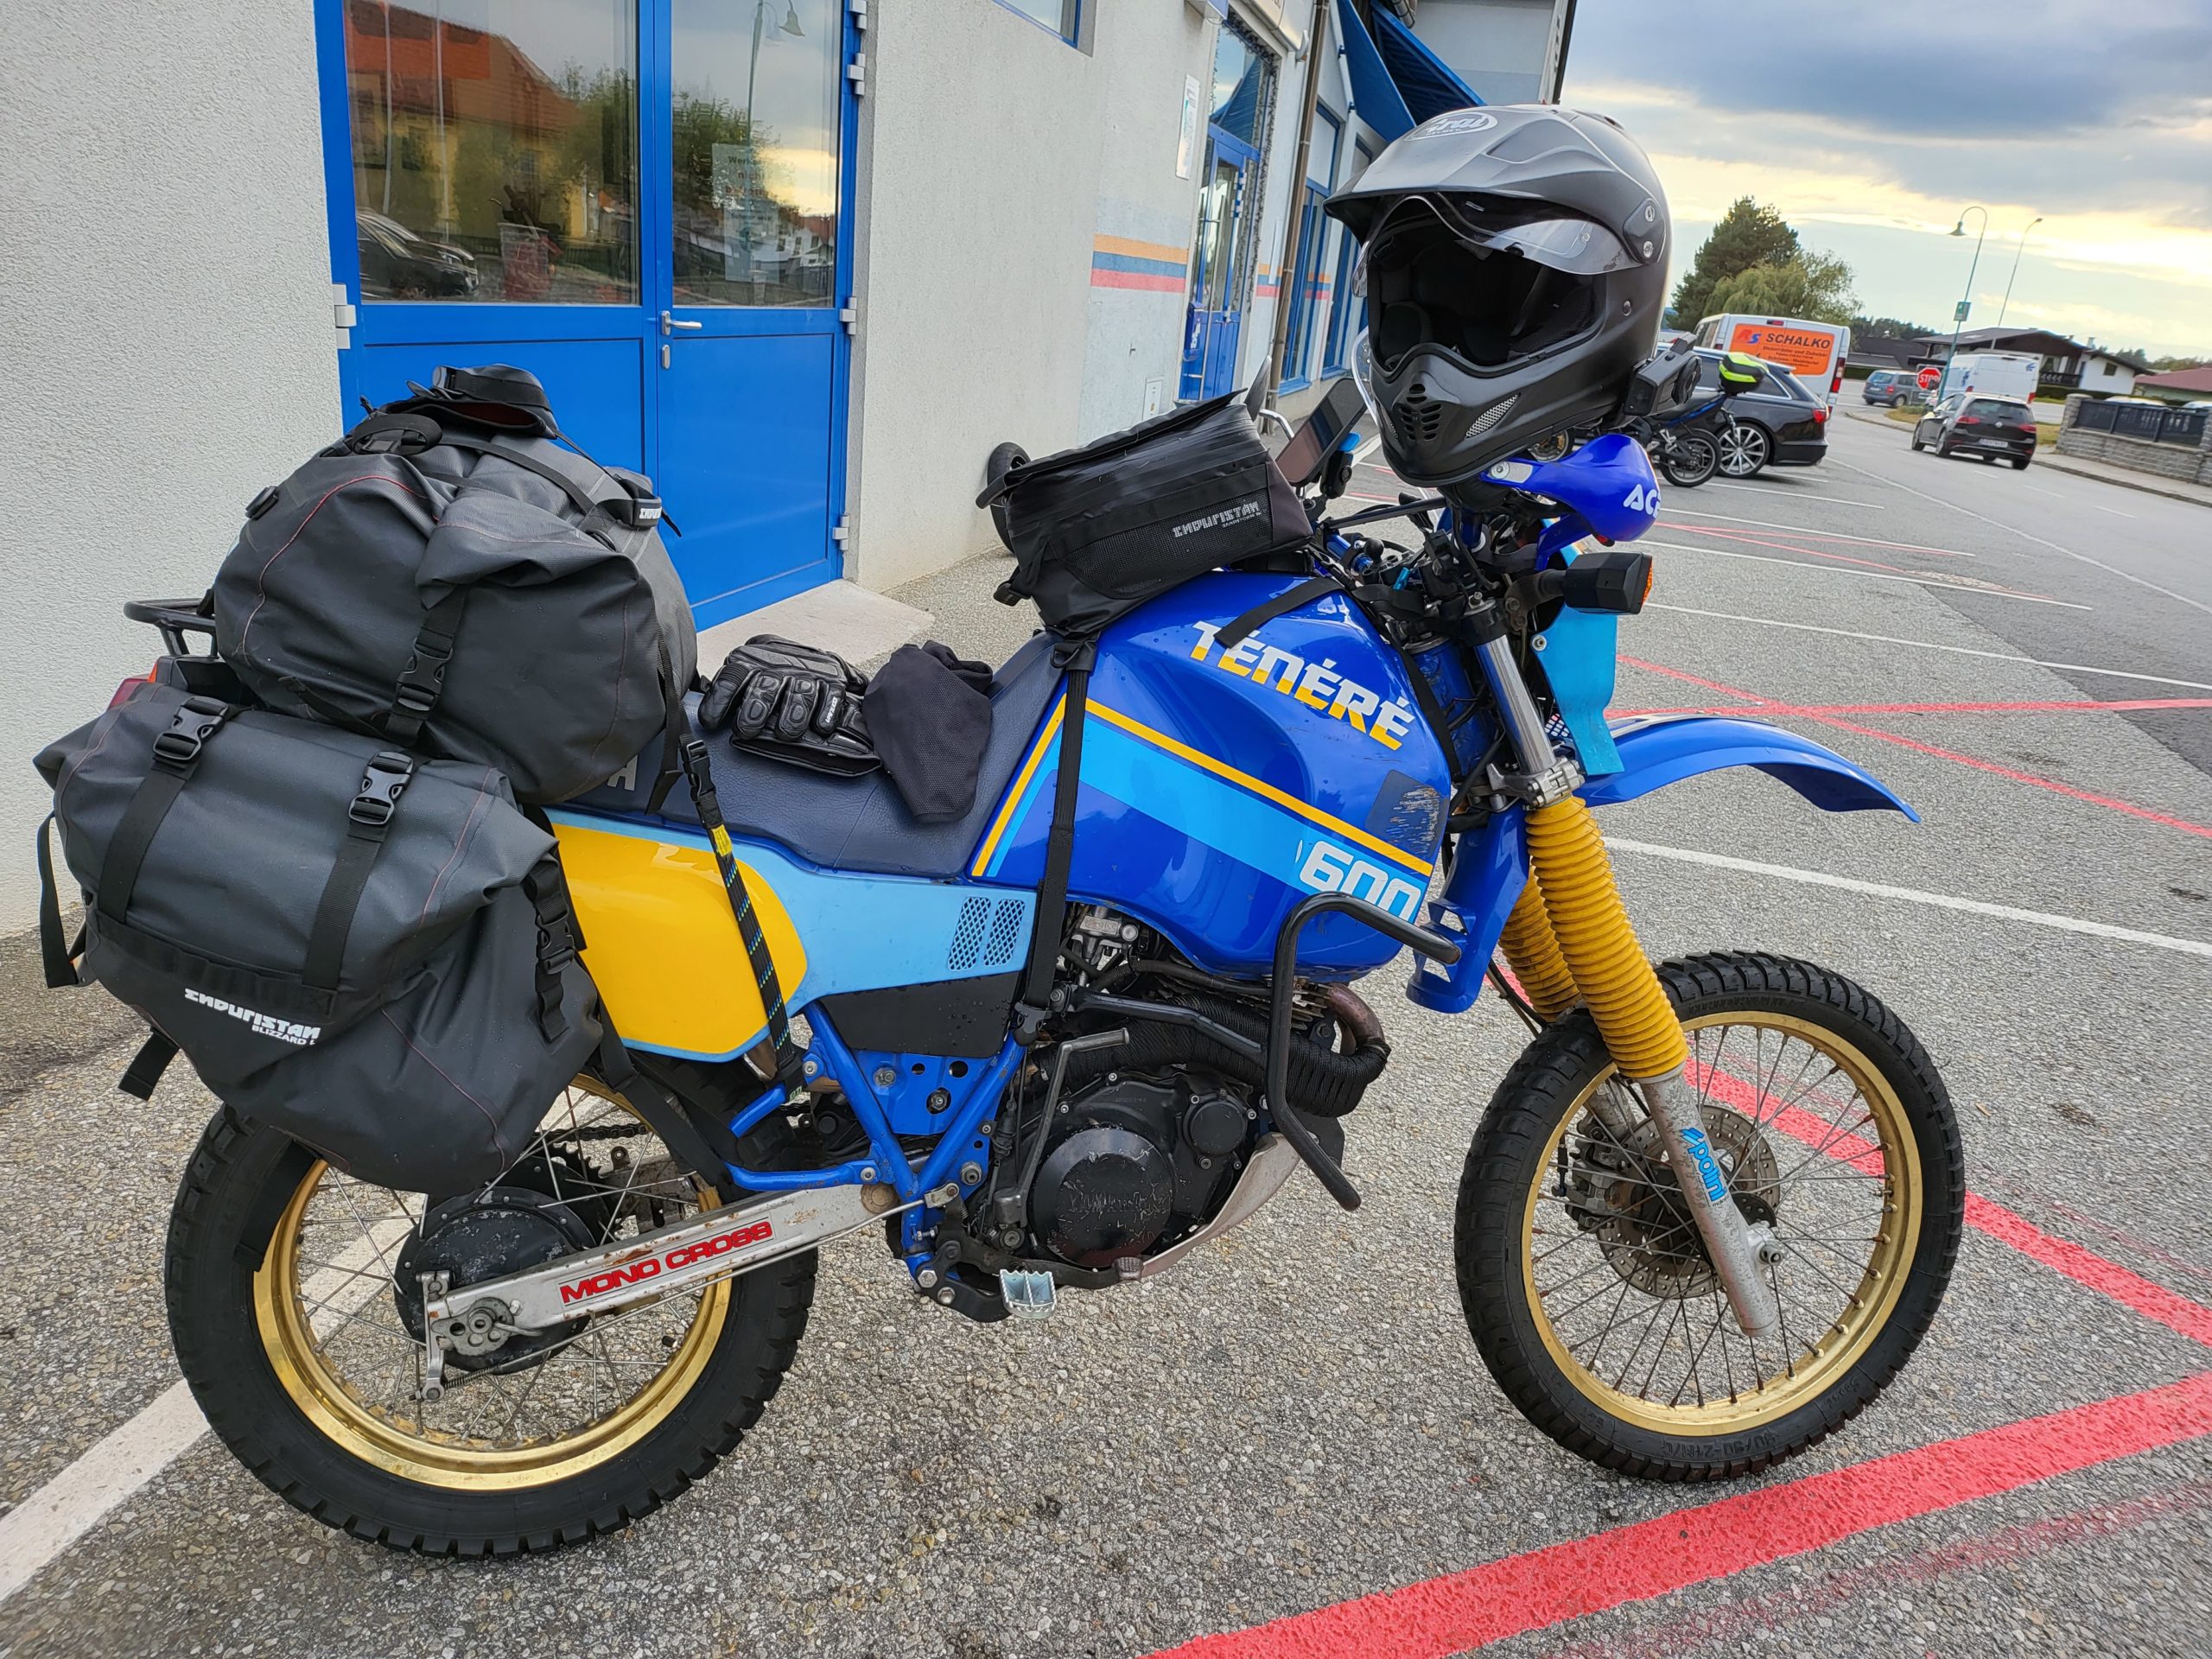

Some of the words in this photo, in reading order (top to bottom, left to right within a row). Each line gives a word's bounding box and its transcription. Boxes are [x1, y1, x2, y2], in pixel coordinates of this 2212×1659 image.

[1765, 333, 1830, 349] SCHALKO
[1173, 501, 1260, 537] ENDURISTAN
[1300, 841, 1422, 924] 600
[184, 988, 321, 1039] ENDURISTAN
[251, 1024, 307, 1046] BLIZZARD
[1688, 1141, 1727, 1202] polini
[560, 1258, 661, 1303] MONO
[665, 1221, 773, 1269] CROSS
